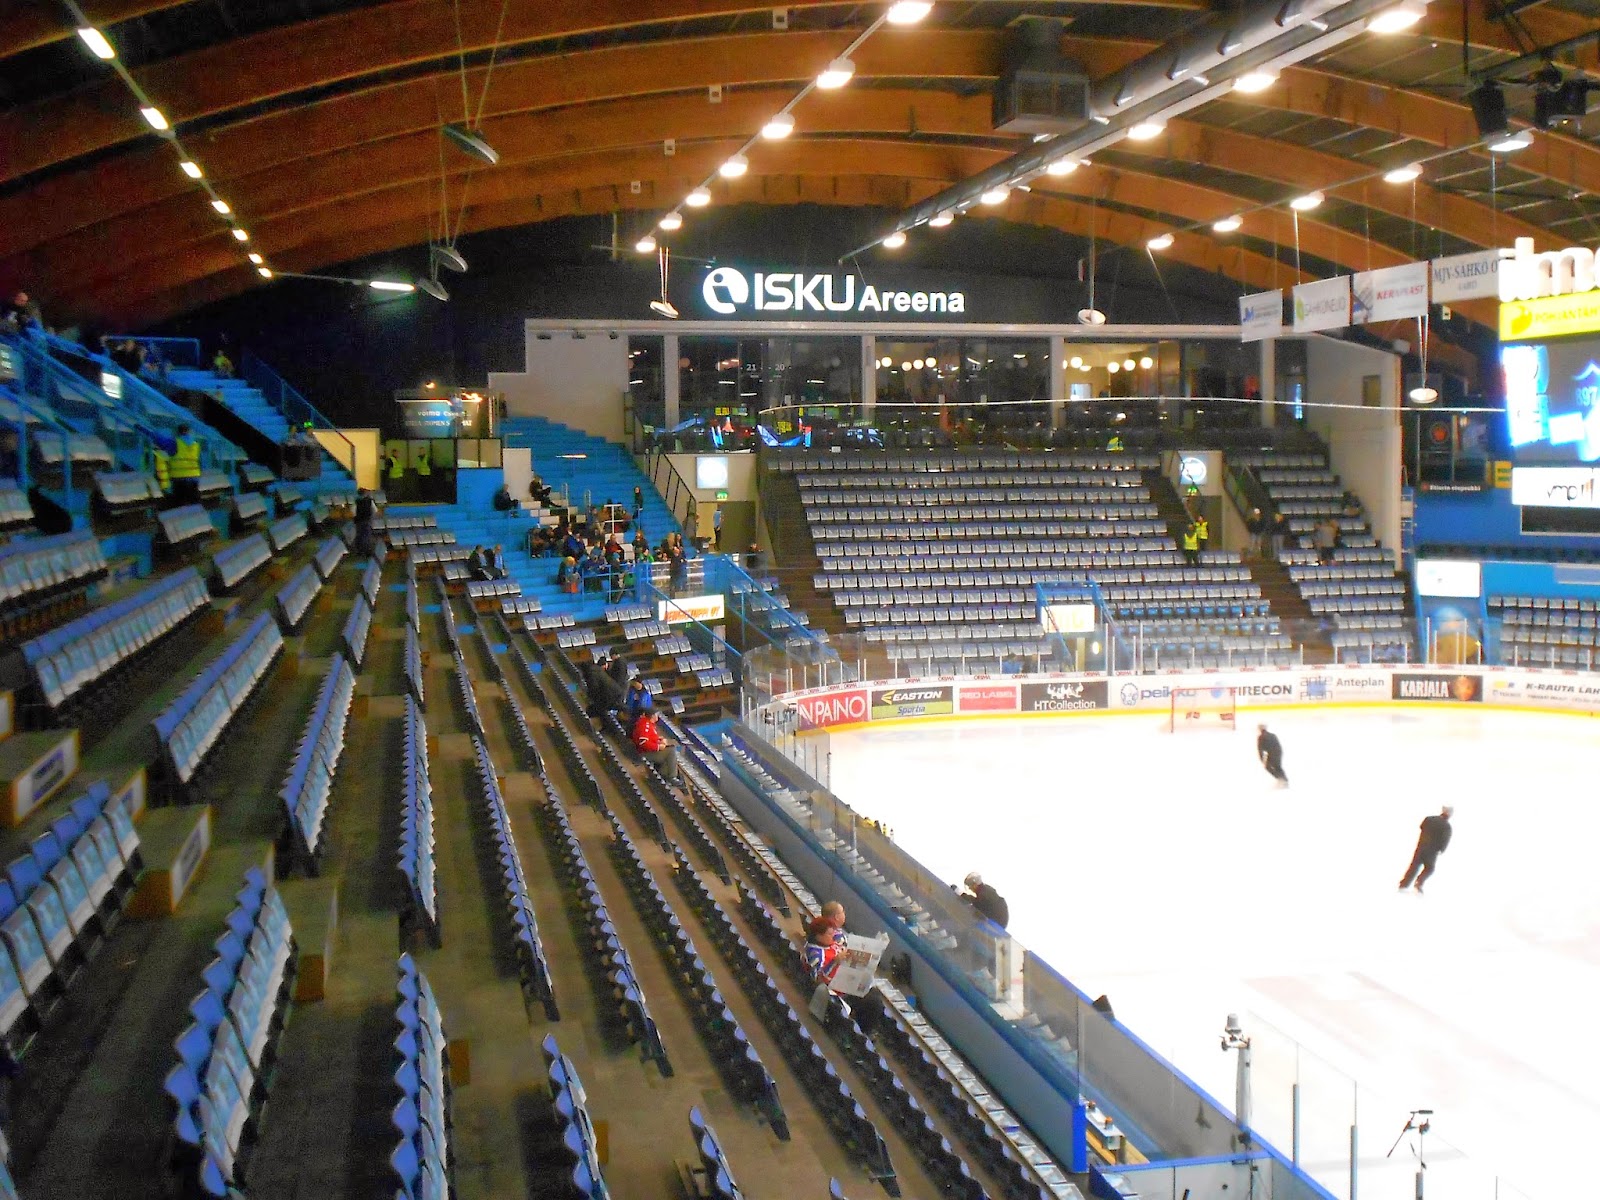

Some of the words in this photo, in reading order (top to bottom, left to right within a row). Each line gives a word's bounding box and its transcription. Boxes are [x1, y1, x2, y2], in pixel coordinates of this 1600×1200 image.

[754, 272, 854, 311] ISKU
[858, 285, 965, 312] Areena
[746, 363, 757, 372] 21
[1336, 677, 1385, 688] Anteplan
[960, 691, 981, 699] RED
[982, 690, 1016, 698] LABEL
[1229, 685, 1292, 697] FIRECON
[1400, 680, 1449, 698] KARJALA
[1526, 683, 1574, 693] K-RAUTA
[1578, 686, 1600, 695] LAH
[892, 690, 943, 702] EASTON
[1034, 699, 1096, 711] HTCollection
